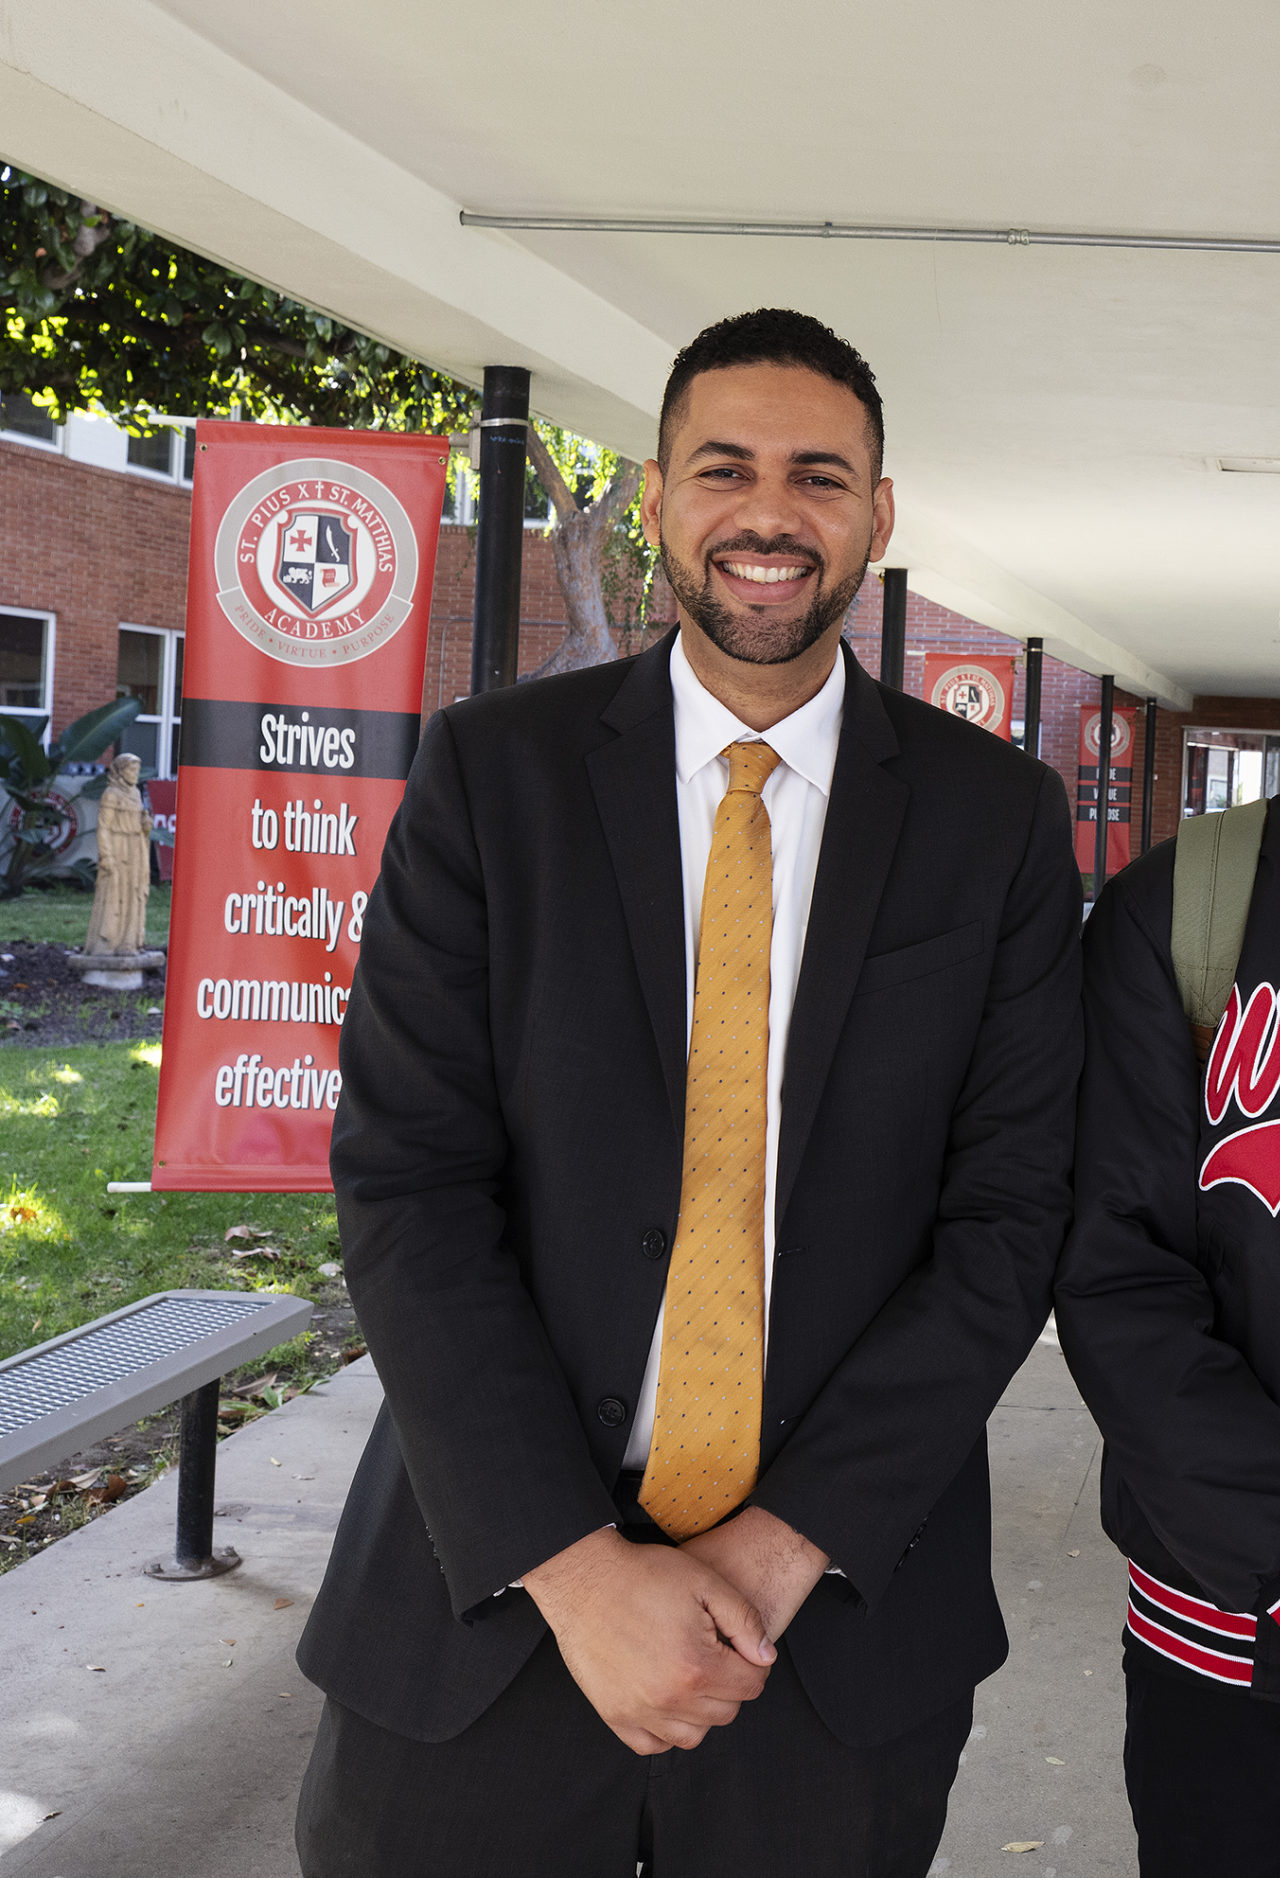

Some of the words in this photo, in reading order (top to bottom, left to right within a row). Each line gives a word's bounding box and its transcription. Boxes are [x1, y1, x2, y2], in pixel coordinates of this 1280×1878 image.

[240, 535, 258, 564] ST.
[251, 489, 291, 529] PIUS
[298, 483, 310, 499] X
[329, 485, 351, 506] ST.
[351, 497, 394, 573] MATTHIAS
[234, 604, 266, 639] PRIDE
[277, 640, 327, 659] VIRTUE
[341, 613, 396, 656] PURPOSE
[264, 607, 367, 639] ACADEMY
[259, 711, 356, 769] Strives
[251, 798, 279, 850] to
[283, 799, 358, 856] think
[224, 880, 345, 953] critically
[347, 890, 369, 943] &
[196, 971, 351, 1026] communic
